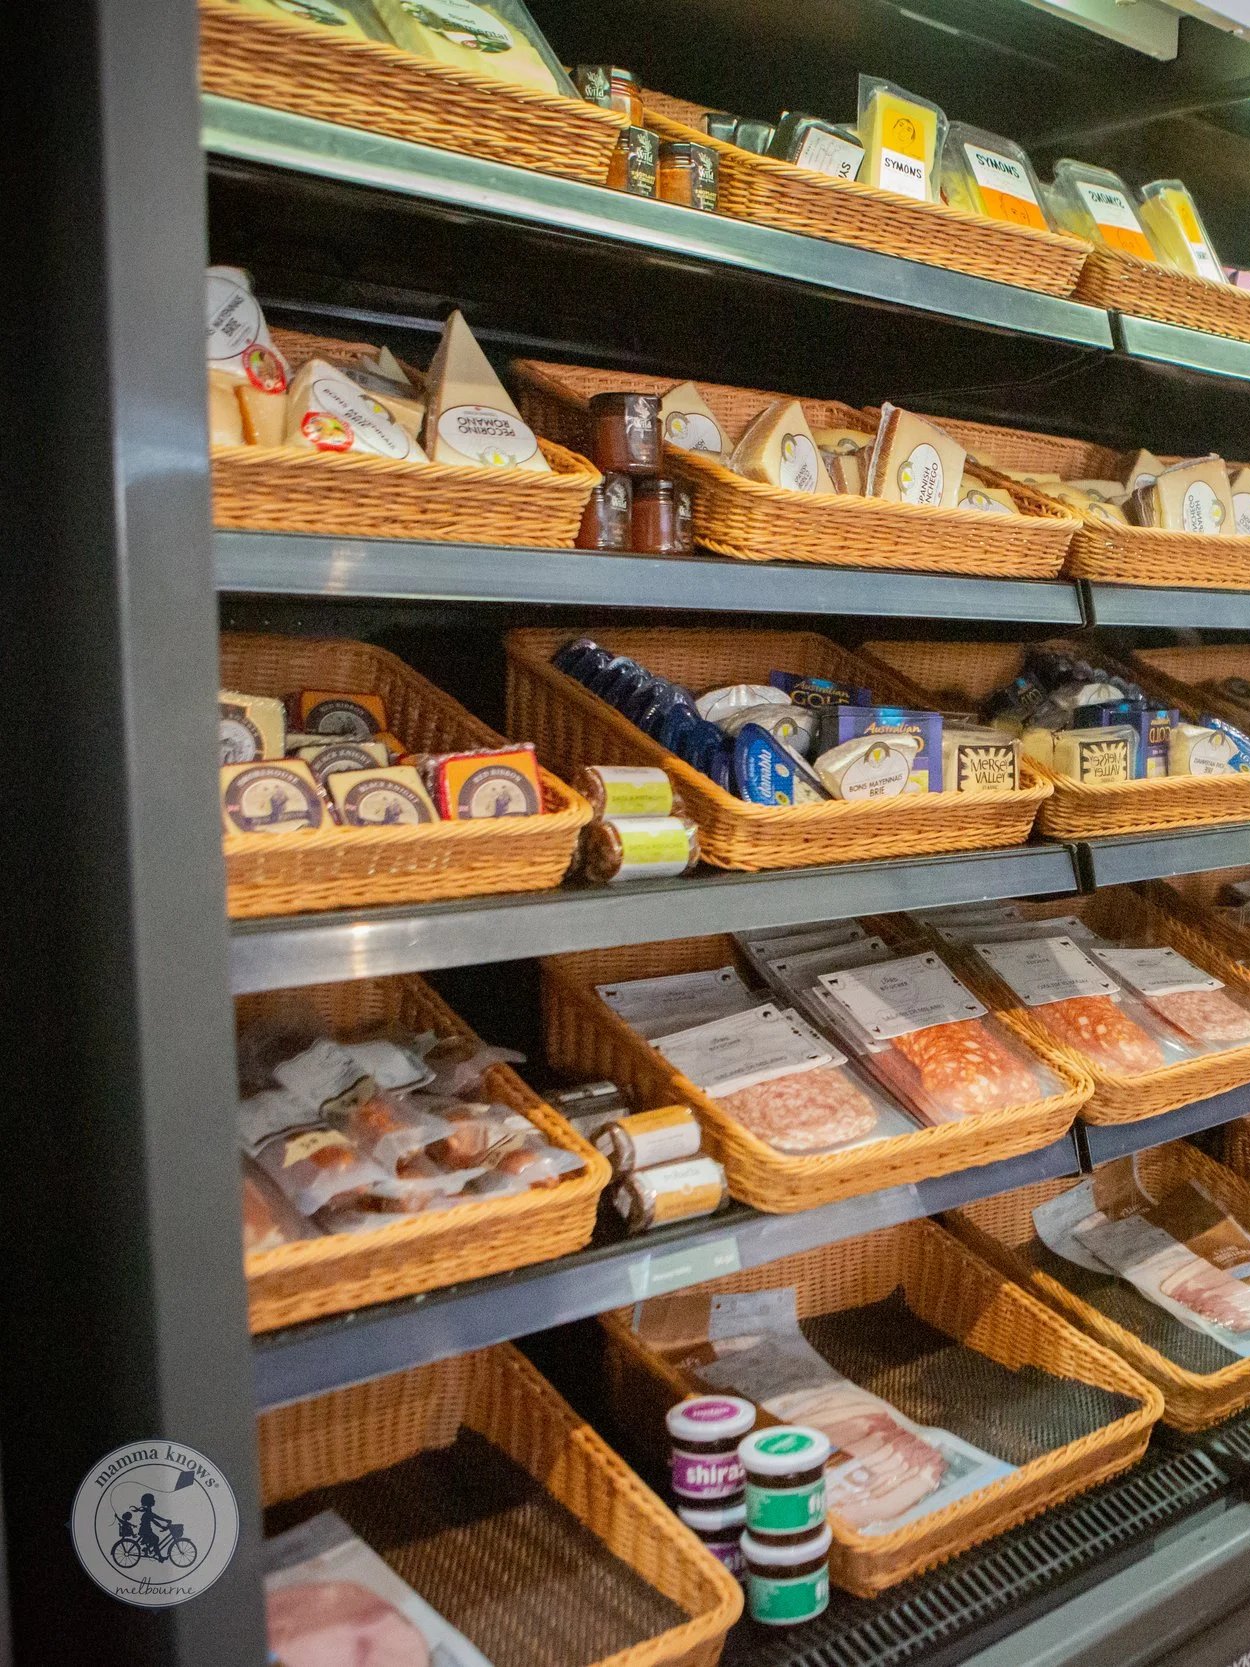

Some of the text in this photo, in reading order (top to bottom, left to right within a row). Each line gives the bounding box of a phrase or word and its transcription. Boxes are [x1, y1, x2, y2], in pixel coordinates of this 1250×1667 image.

[585, 84, 604, 97] Wild
[636, 146, 654, 163] Wild
[697, 166, 714, 181] Wild
[884, 156, 923, 179] SYMONS
[975, 153, 1020, 179] SYMONS
[456, 416, 510, 428] ROMANO
[457, 425, 516, 437] PECORINO
[926, 462, 939, 505] NCHEGO
[793, 680, 850, 698] Australian
[864, 721, 922, 735] Australian
[473, 766, 522, 783] RED RIBBON
[759, 748, 772, 799] danablu
[849, 773, 903, 793] BONS MAYENNAIS
[869, 786, 886, 797] BRIE
[386, 782, 420, 805] KNIGHT
